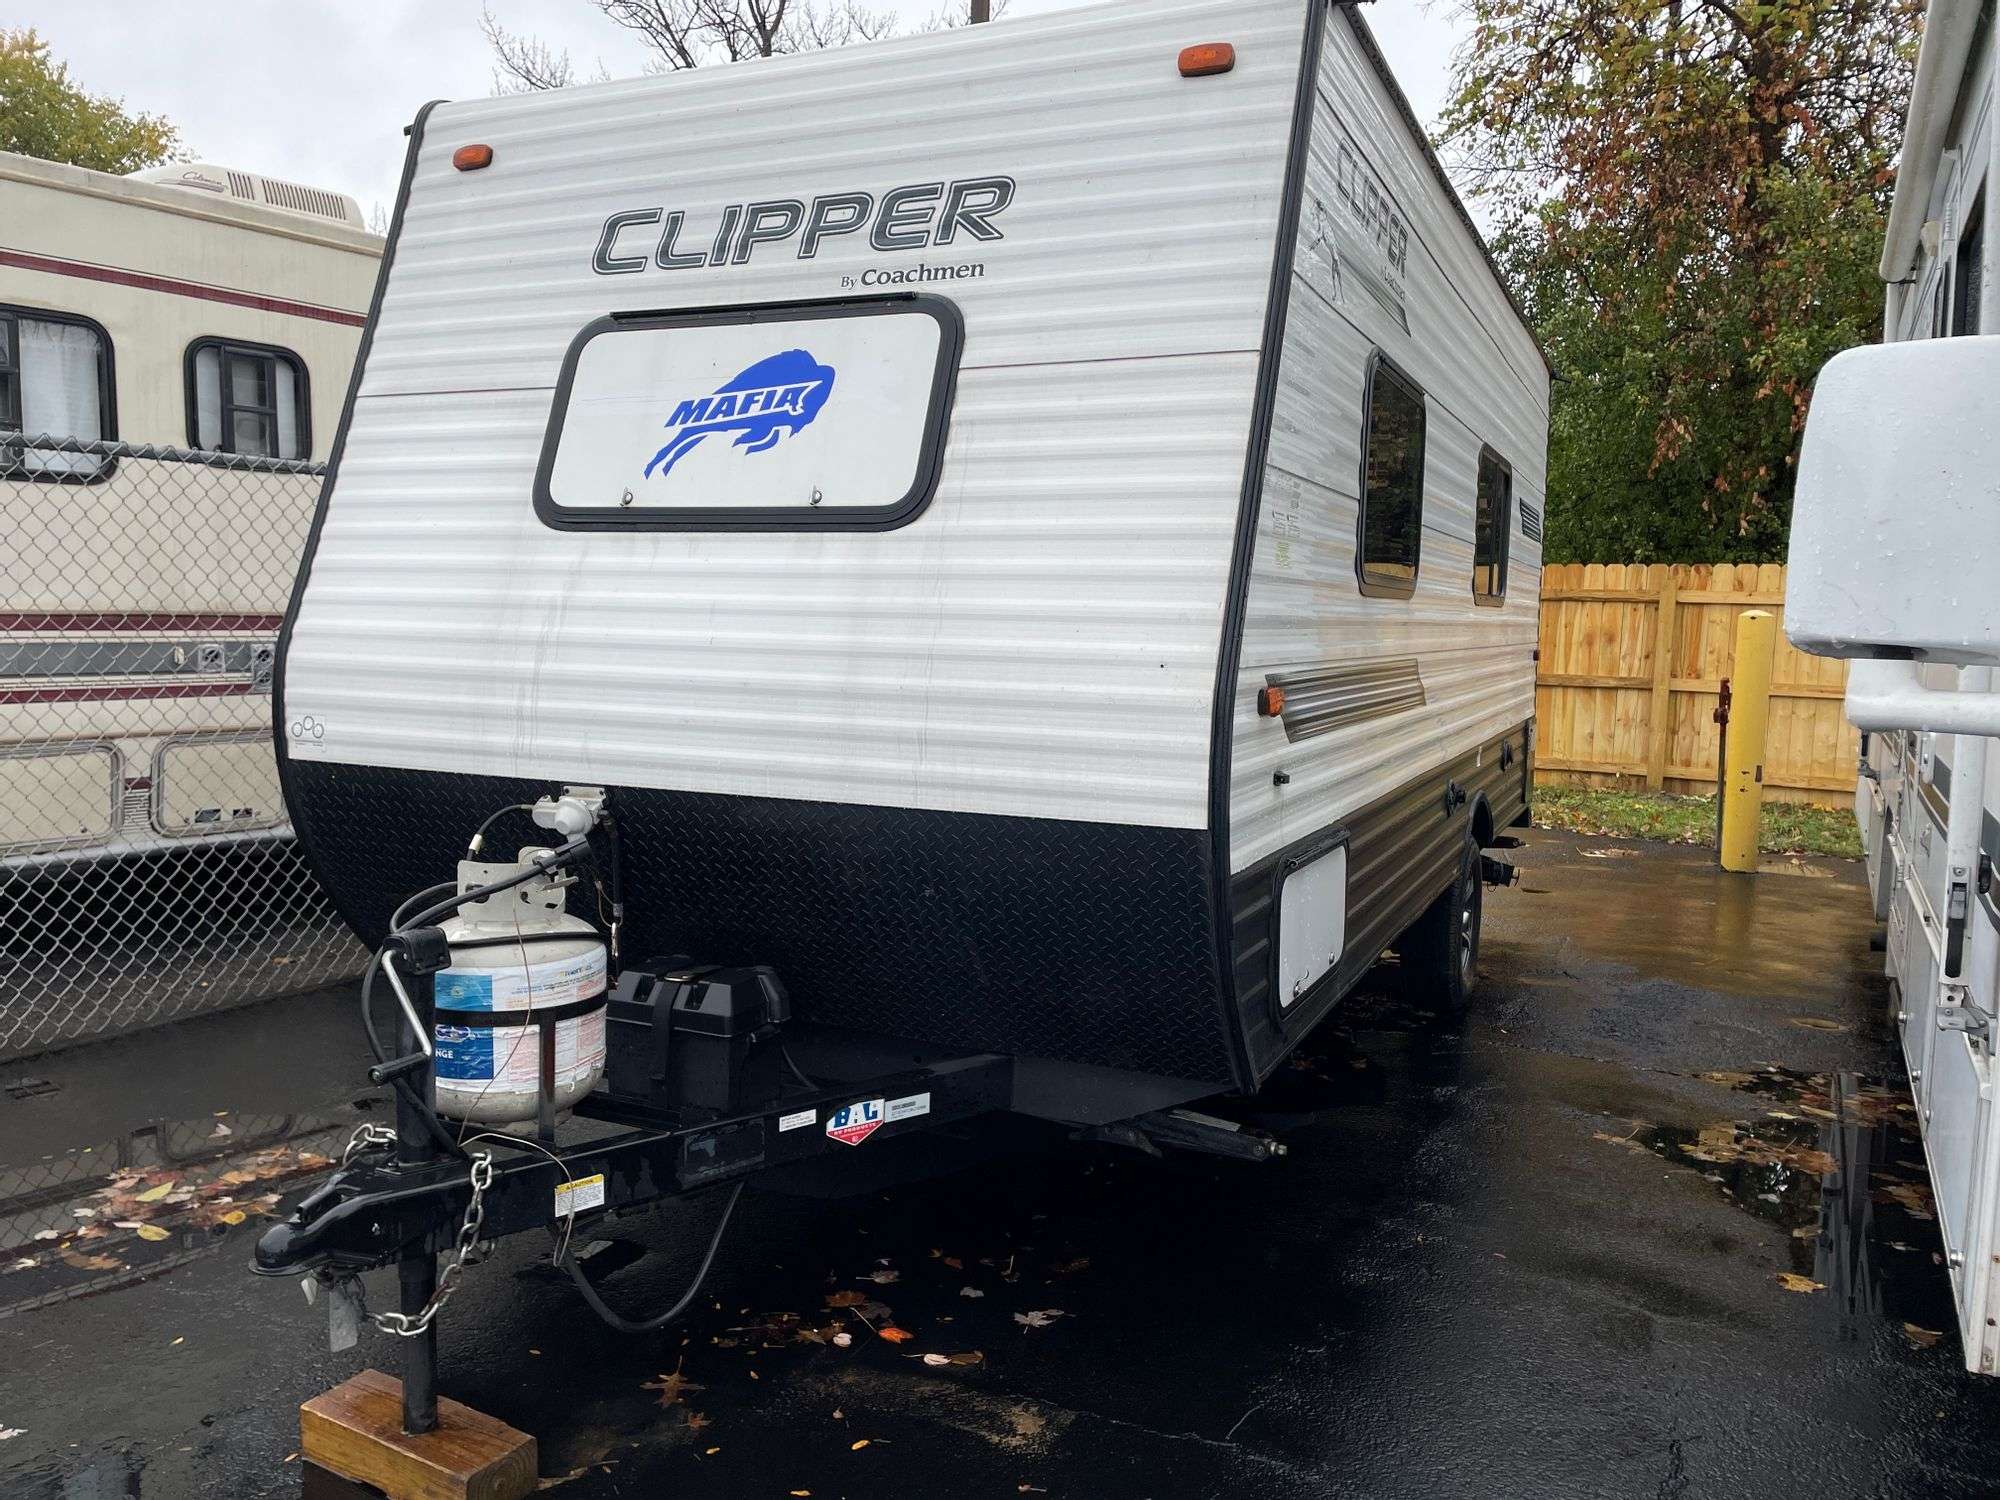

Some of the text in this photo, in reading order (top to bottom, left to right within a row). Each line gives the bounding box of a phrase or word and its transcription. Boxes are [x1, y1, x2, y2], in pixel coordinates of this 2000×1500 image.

[592, 175, 1016, 275] CLIPPER
[840, 263, 985, 290] By Coachmen
[664, 384, 812, 428] MAFIA
[435, 1049, 454, 1059] NGE
[834, 1102, 878, 1128] BAL
